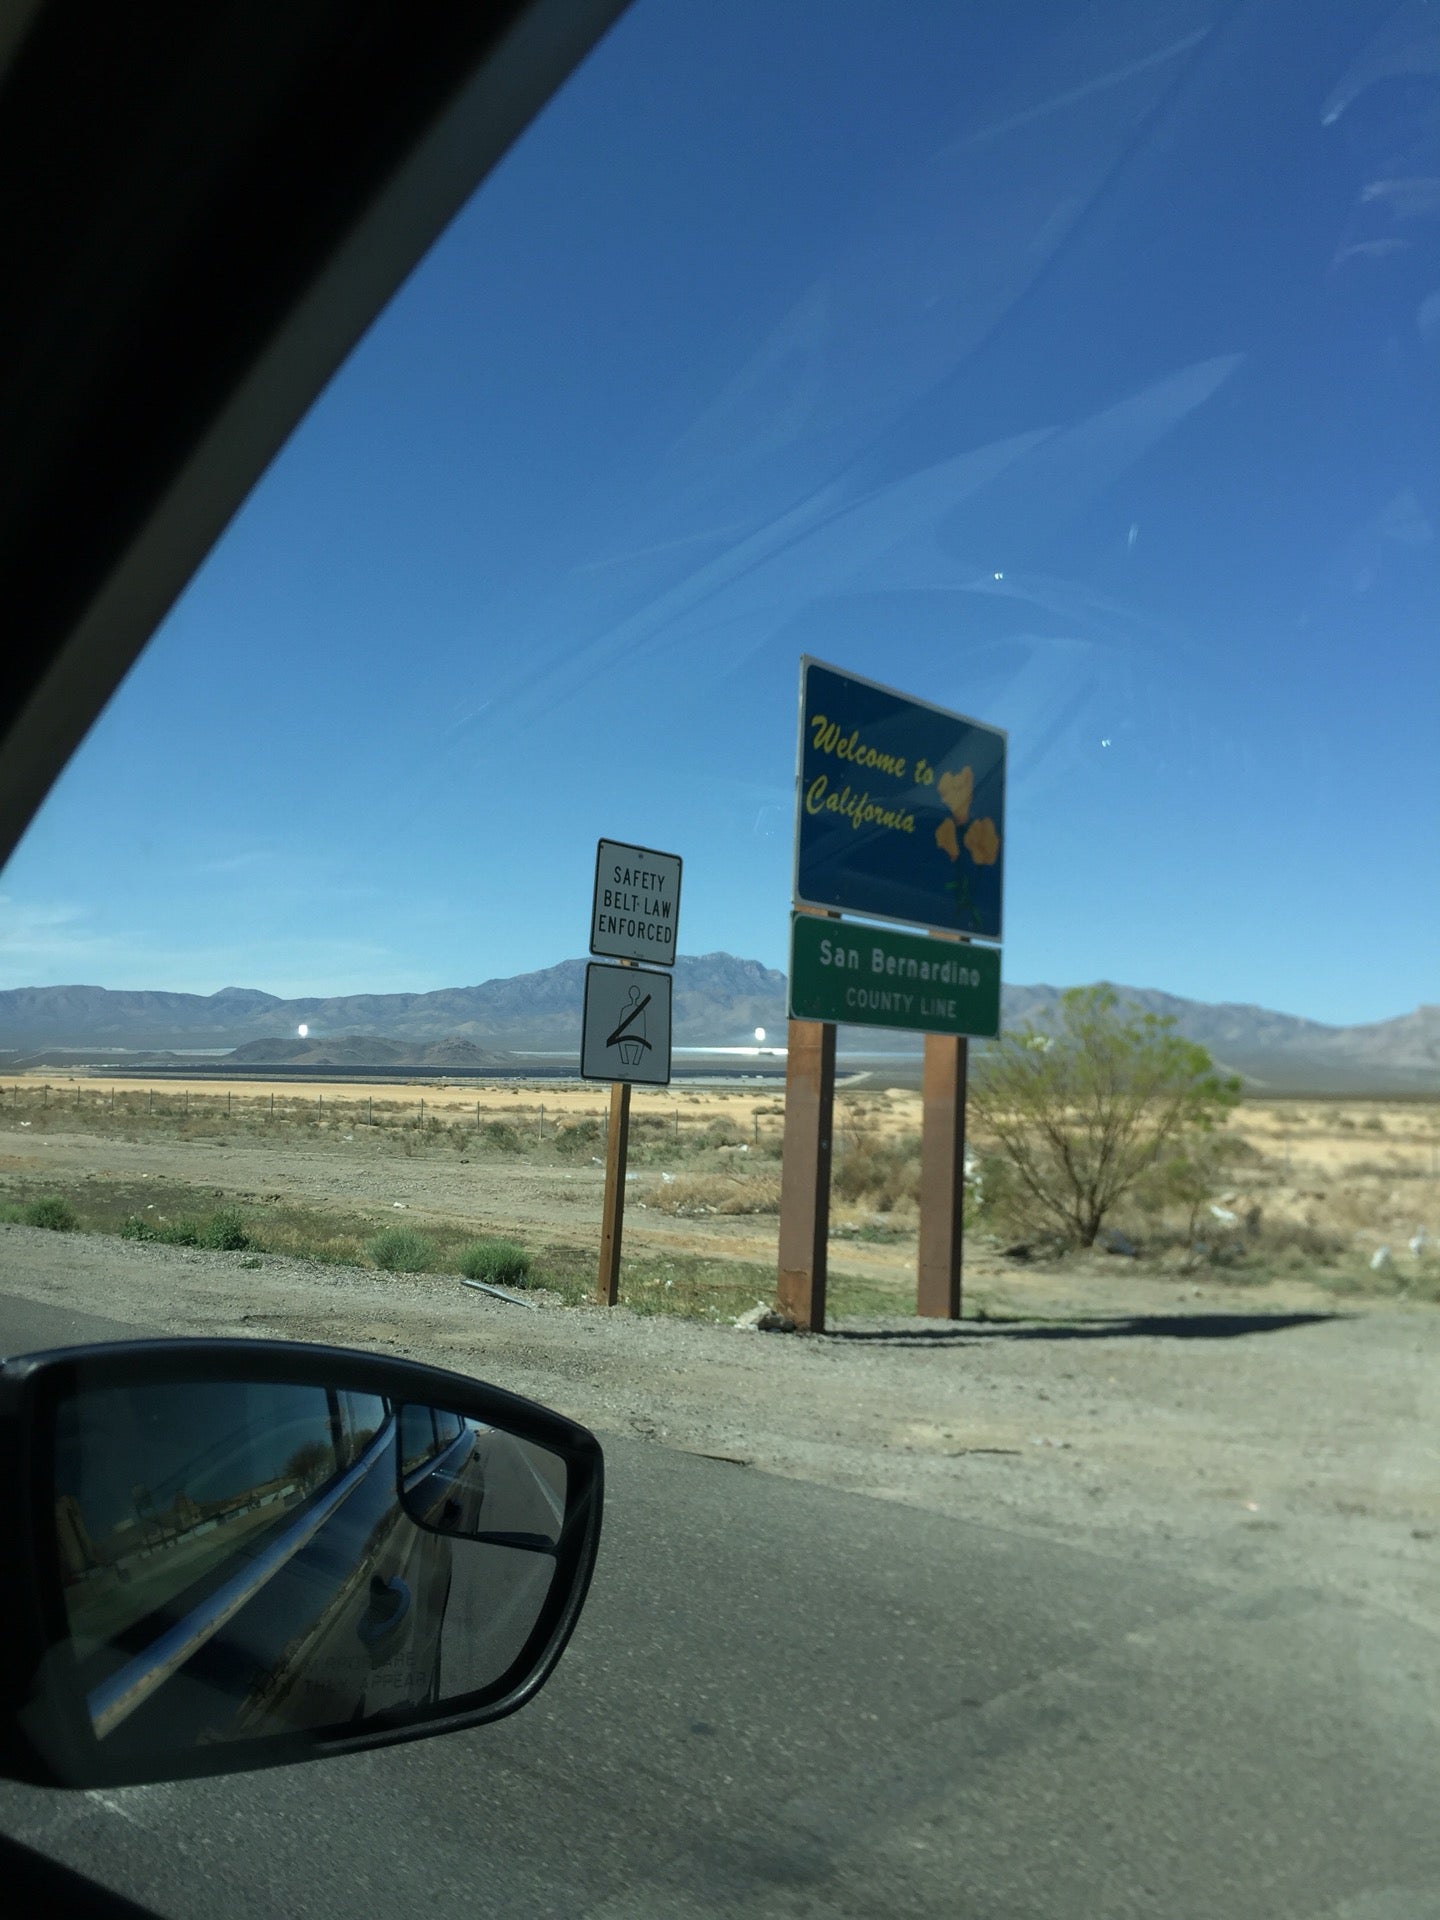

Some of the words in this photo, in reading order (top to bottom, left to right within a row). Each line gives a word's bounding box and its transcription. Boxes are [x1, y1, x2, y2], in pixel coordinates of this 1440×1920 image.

[811, 715, 906, 777] Welcome
[914, 758, 934, 785] to
[806, 774, 915, 833] California
[613, 865, 665, 892] SAFETY
[603, 889, 638, 912] BELT
[644, 897, 671, 918] LAW
[599, 914, 672, 944] ENFORCED
[820, 939, 859, 969] San
[871, 948, 980, 987] Bernardino
[846, 987, 914, 1013] COUNTY
[920, 999, 957, 1018] LINE
